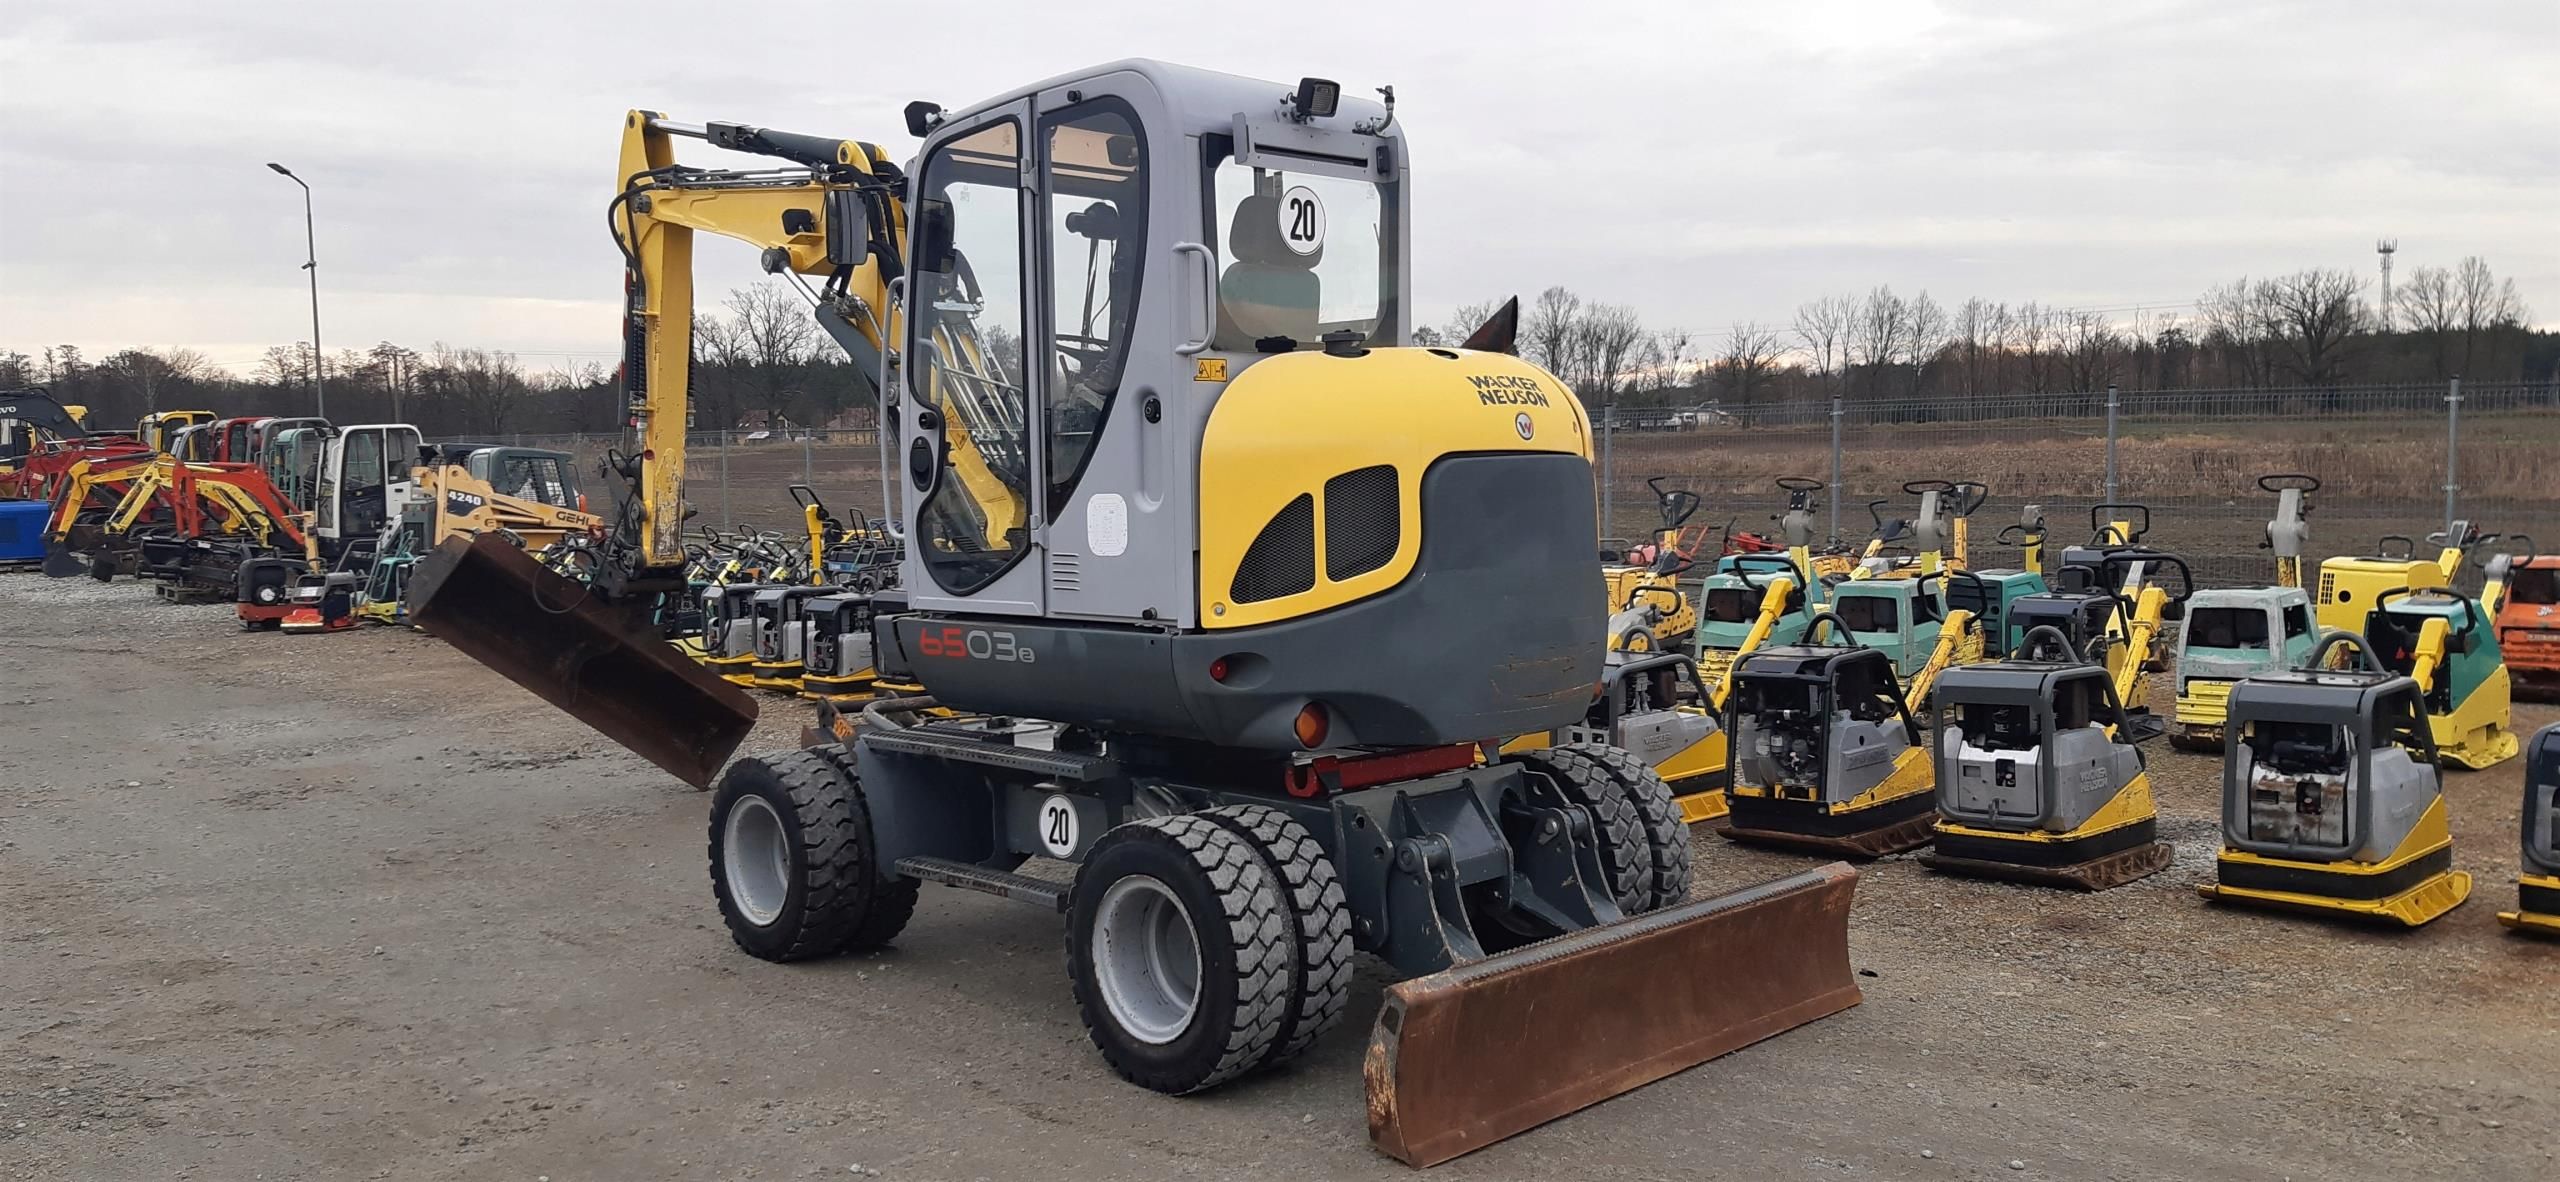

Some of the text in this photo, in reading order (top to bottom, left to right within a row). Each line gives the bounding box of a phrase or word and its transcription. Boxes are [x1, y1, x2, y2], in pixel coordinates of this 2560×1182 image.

[1290, 198, 1316, 242] 20
[1465, 375, 1542, 392] WACKER
[1477, 389, 1550, 408] NEUSON
[448, 490, 482, 506] 4240
[1048, 806, 1069, 846] 20
